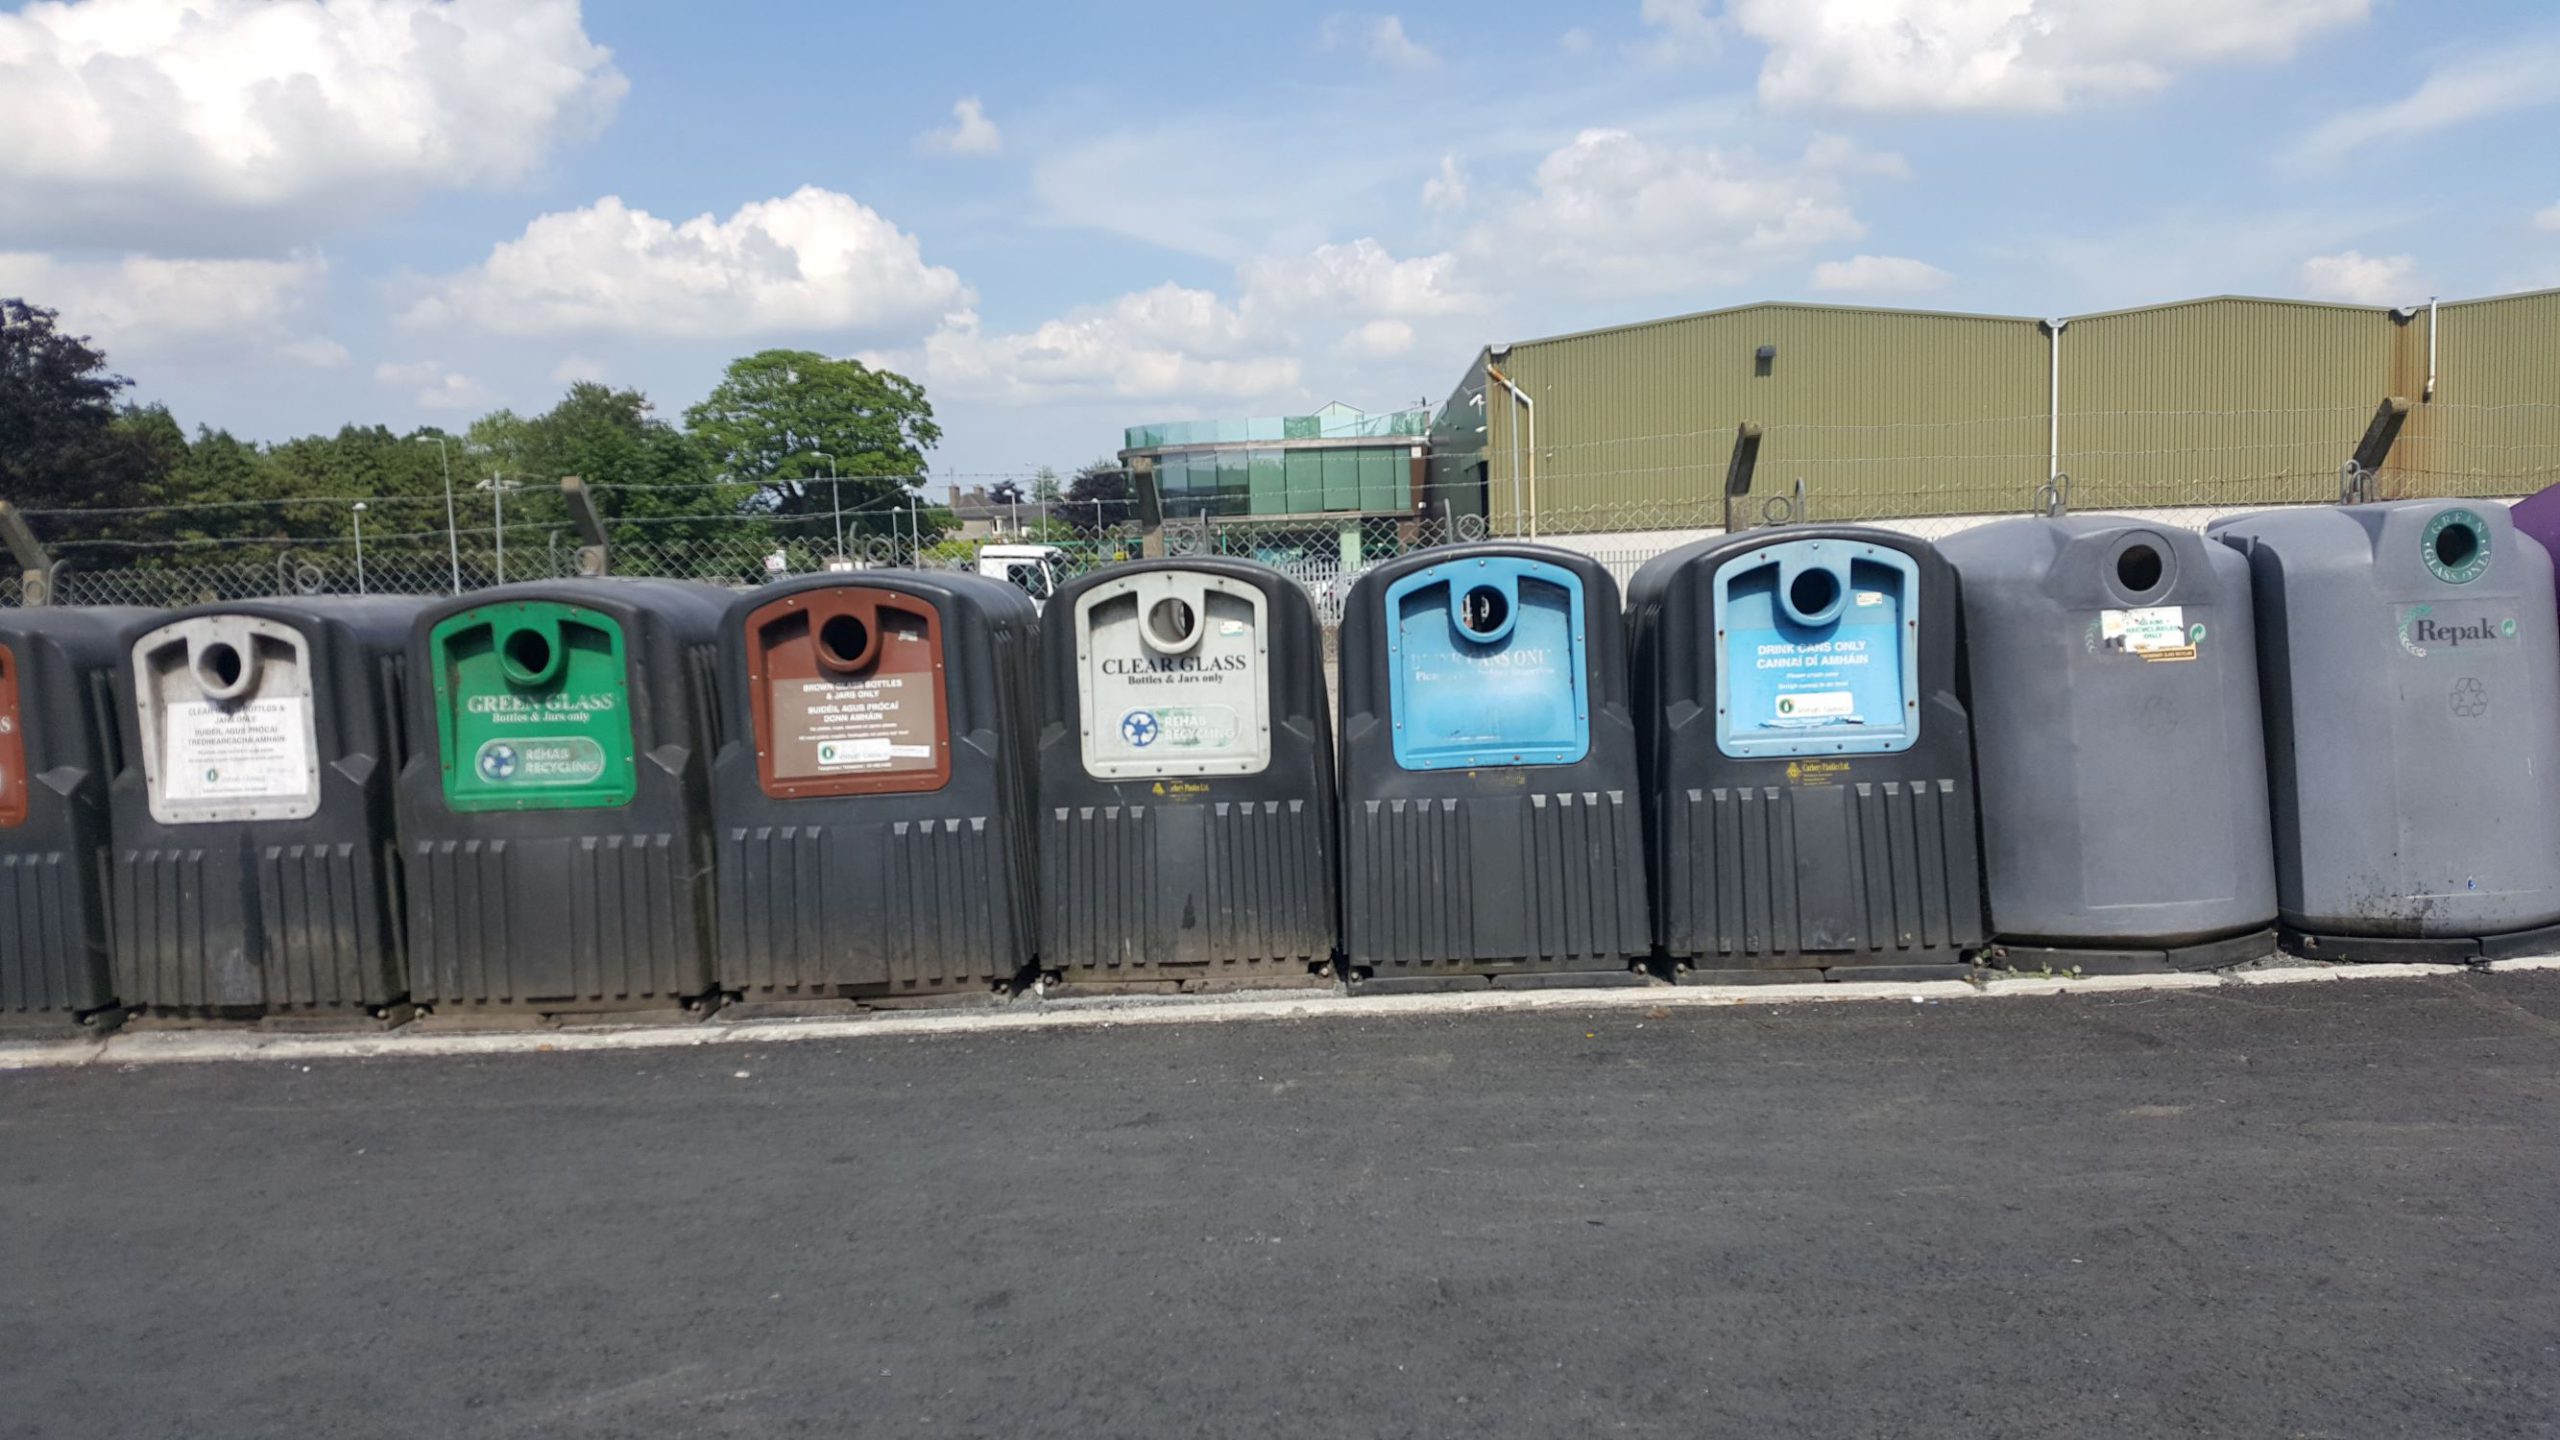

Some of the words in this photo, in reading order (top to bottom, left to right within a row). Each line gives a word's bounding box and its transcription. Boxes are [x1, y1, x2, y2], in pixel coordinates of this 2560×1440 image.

[2416, 617, 2497, 646] Repak
[1757, 644, 1794, 655] DRINK
[1797, 642, 1832, 654] CANS
[1834, 640, 1866, 652] ONLY
[1101, 656, 1175, 675] CLEAR
[1178, 654, 1247, 673] GLASS
[803, 683, 834, 693] BROWN
[865, 679, 903, 689] BOTTLES
[1128, 675, 1162, 685] Bottles
[1165, 674, 1175, 684] &
[1178, 673, 1200, 684] Jars
[1202, 673, 1224, 685] only
[834, 690, 856, 699] JARS
[857, 689, 880, 699] ONLY
[467, 694, 541, 713] GREEN
[545, 692, 614, 711] GLASS
[492, 712, 528, 723] Bottles
[529, 712, 540, 722] &
[542, 711, 564, 722] Jars
[564, 711, 590, 724] only
